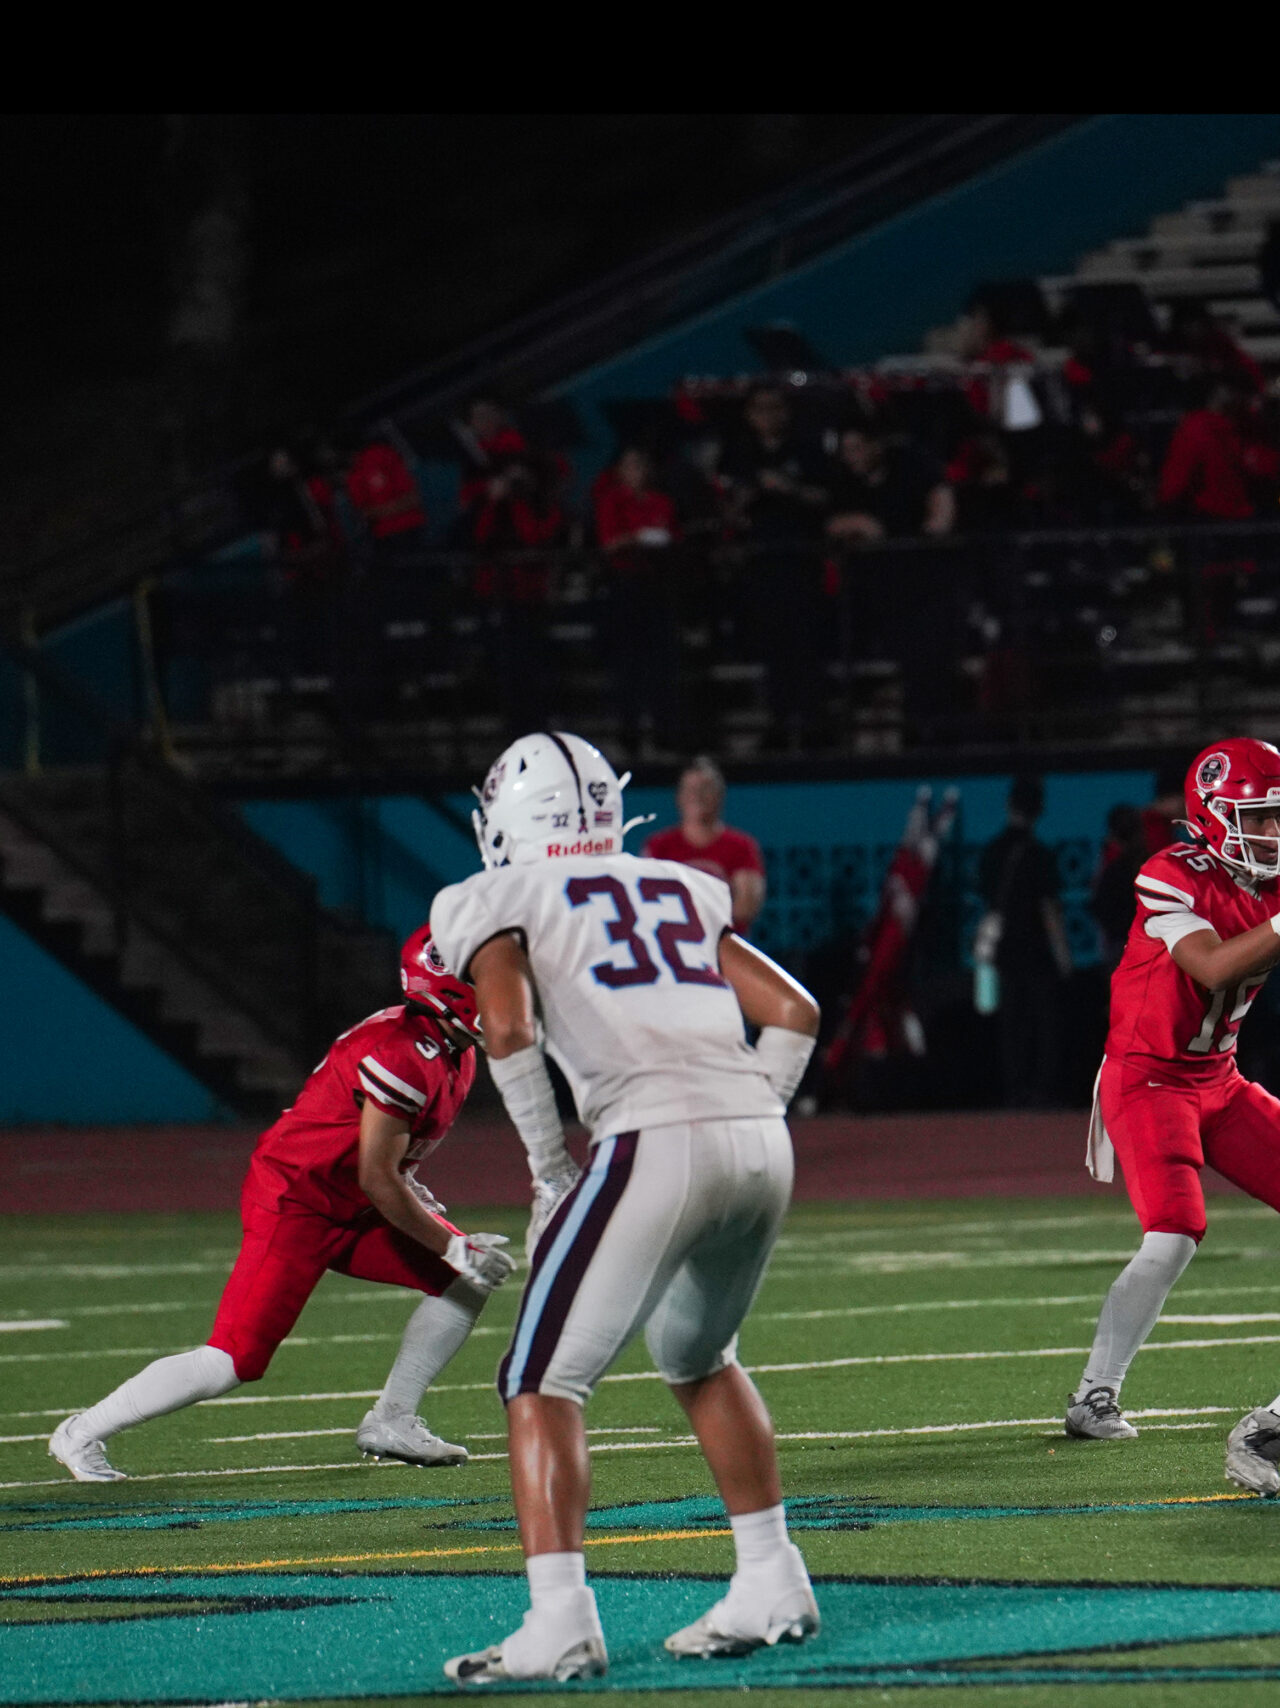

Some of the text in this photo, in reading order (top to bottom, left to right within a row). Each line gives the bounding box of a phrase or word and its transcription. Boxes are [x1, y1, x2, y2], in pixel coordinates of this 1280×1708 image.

[547, 838, 613, 858] Riddell
[1169, 849, 1217, 873] 15
[563, 874, 731, 991] 32
[1186, 971, 1271, 1054] 15
[414, 1034, 441, 1060] 3
